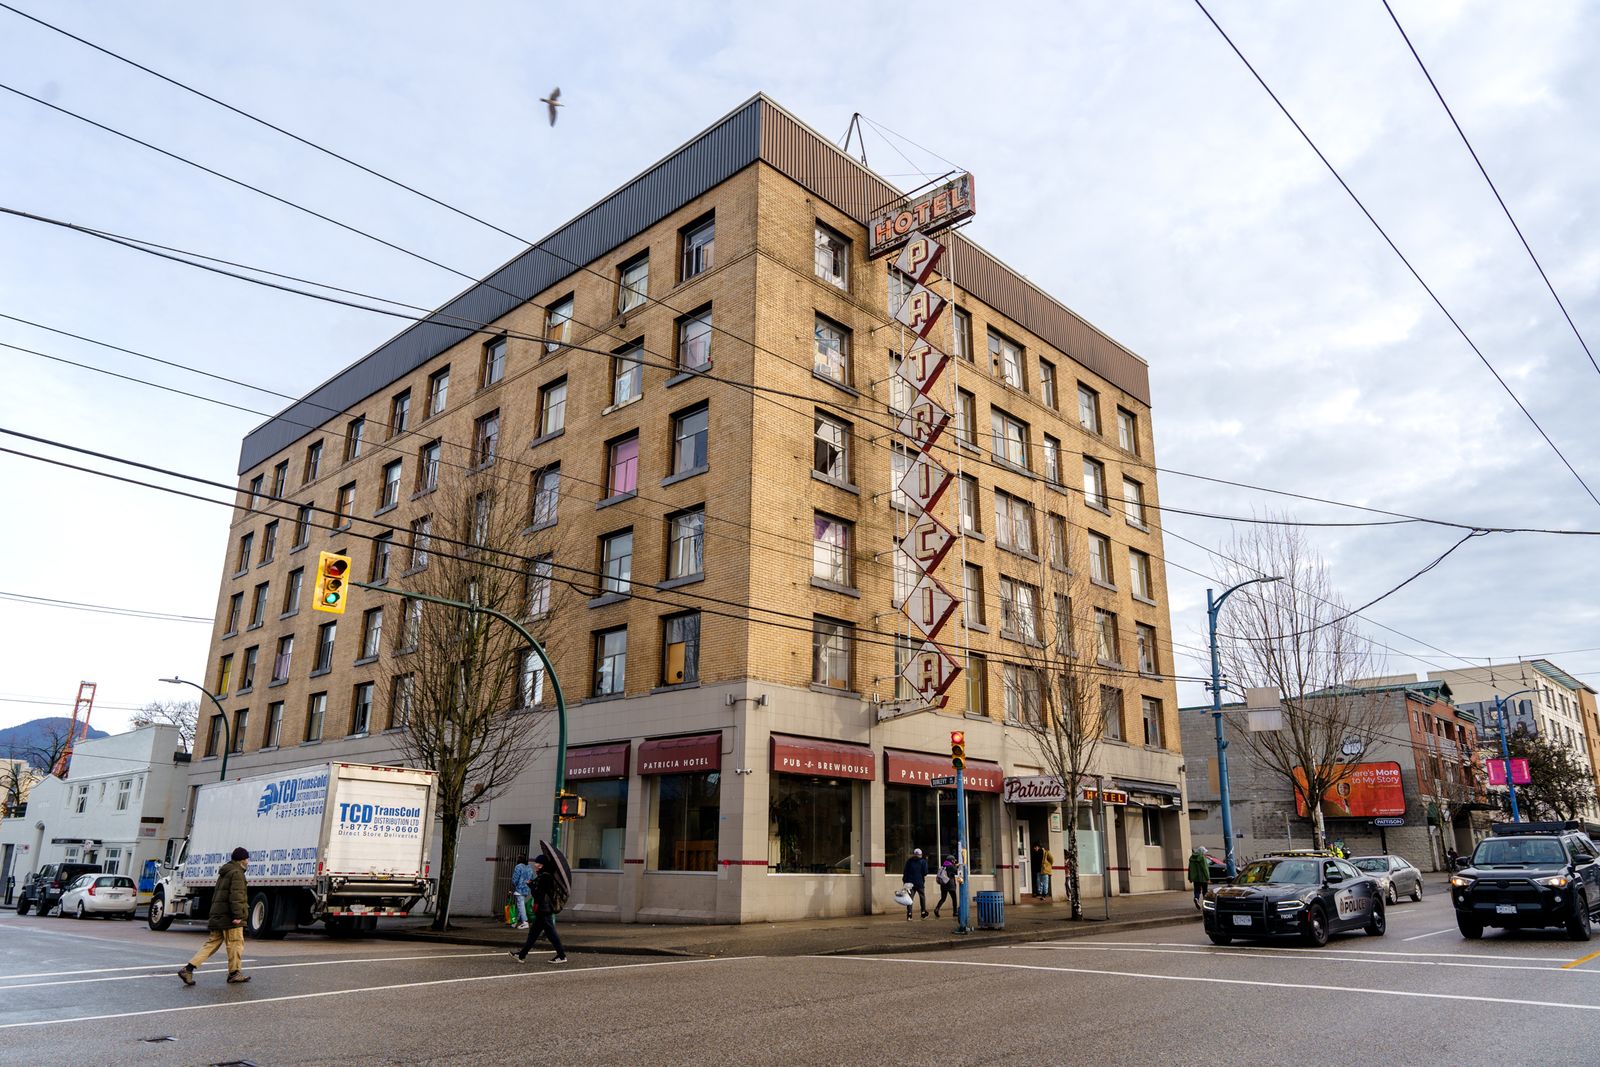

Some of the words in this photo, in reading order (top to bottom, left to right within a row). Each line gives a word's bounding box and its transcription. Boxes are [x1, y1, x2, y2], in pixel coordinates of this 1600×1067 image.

[874, 186, 967, 246] HOTEL
[906, 239, 943, 695] PATRICIA
[643, 760, 679, 769] PATRICIA
[683, 757, 709, 766] HOTEL
[783, 758, 801, 767] PUB
[817, 761, 869, 774] BREWHOUSE
[569, 767, 594, 775] BUDGET
[297, 774, 328, 790] TransCold
[901, 769, 955, 783] PATRI
[963, 777, 994, 787] HOTEL
[1362, 776, 1376, 785] My
[1378, 776, 1400, 784] Story
[278, 779, 298, 803] TCD
[1006, 780, 1061, 800] Patricia
[1087, 791, 1124, 802] HTEL
[275, 805, 324, 818] 1-877-519-0600
[340, 803, 374, 823] TCD
[374, 805, 421, 818] TransCold
[339, 823, 419, 834] 1-877-519-0600
[373, 817, 409, 826] DISTRIBUTION
[409, 818, 420, 827] LTD
[291, 847, 318, 860] BURLINGTON
[296, 862, 316, 875] SEATTLE
[1344, 900, 1367, 914] POLICE
